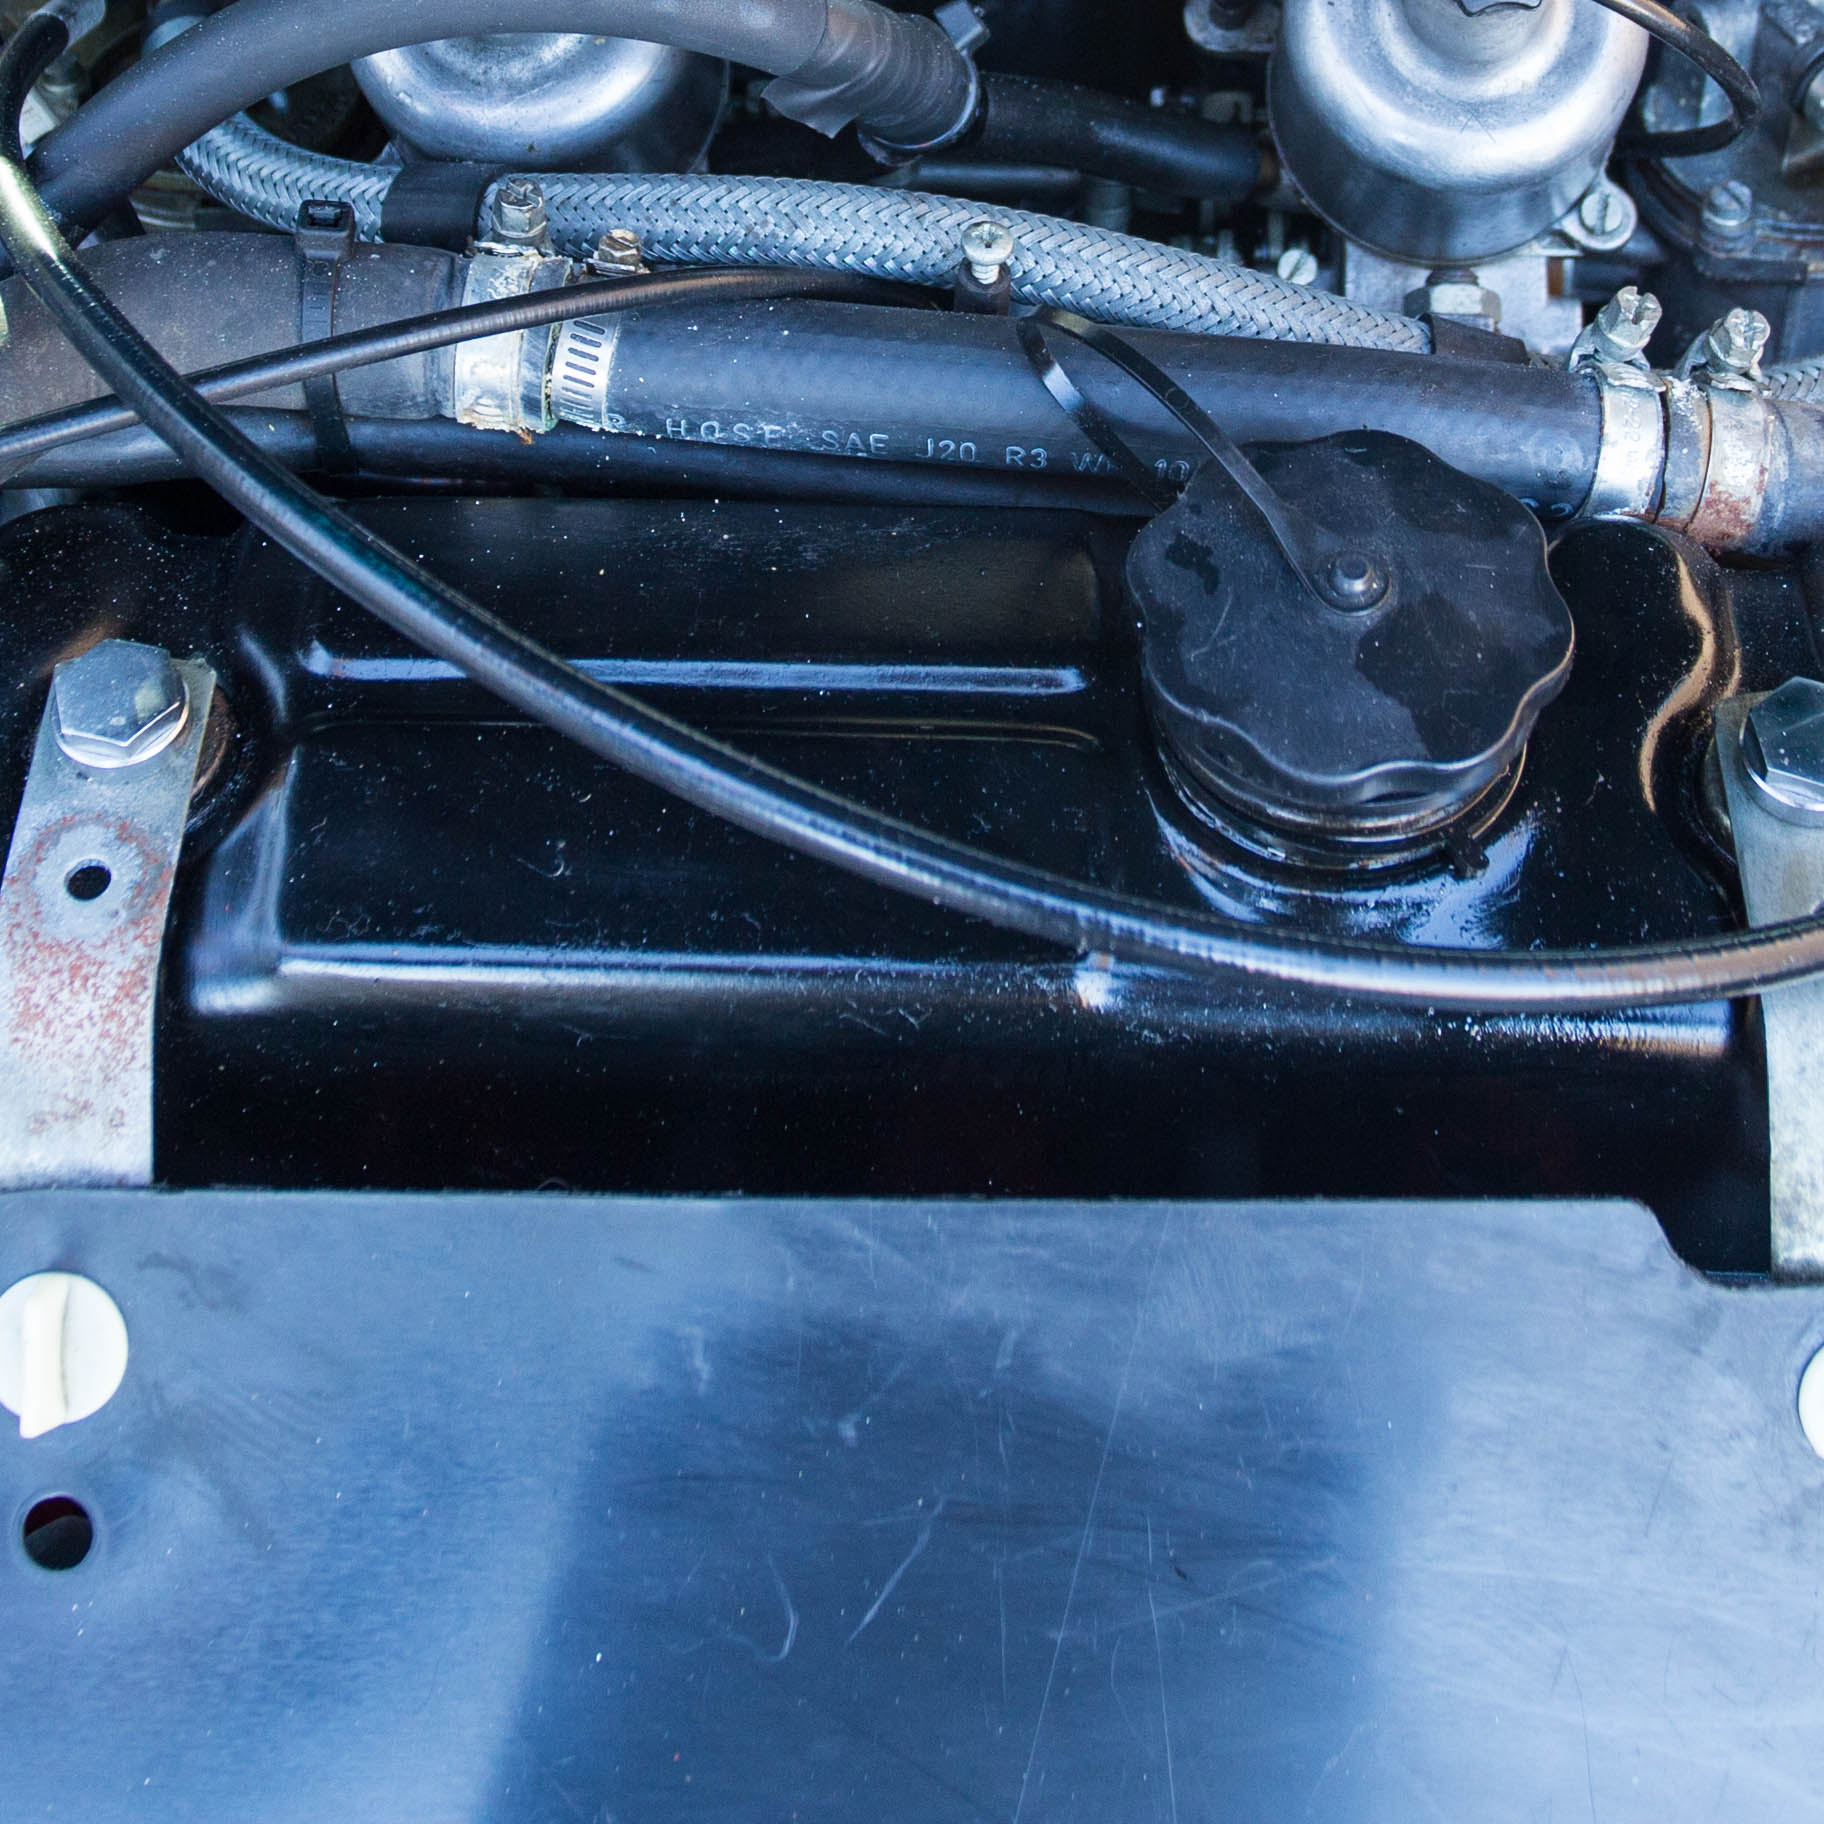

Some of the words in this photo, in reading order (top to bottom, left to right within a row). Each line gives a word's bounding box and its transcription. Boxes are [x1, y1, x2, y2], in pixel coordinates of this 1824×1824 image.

[821, 429, 890, 458] SAE
[916, 438, 978, 463] J20
[1005, 445, 1049, 471] R3
